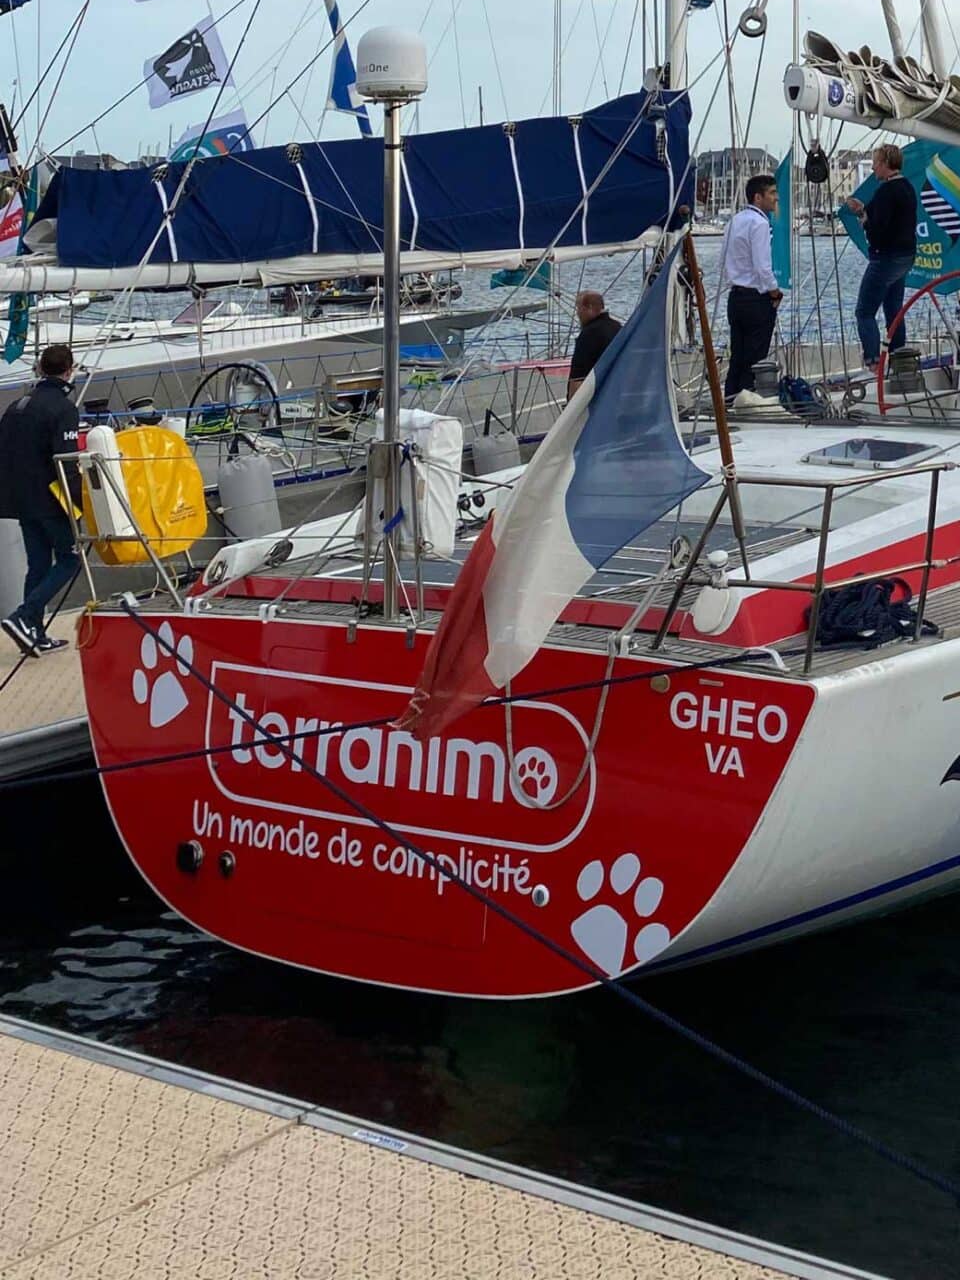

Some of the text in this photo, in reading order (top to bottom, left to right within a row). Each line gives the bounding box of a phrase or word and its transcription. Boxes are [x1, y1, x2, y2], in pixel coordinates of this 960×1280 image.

[670, 691, 788, 743] GHEO
[704, 742, 745, 778] VA
[193, 799, 223, 838] Un
[230, 814, 321, 861] monde
[326, 827, 364, 868] de
